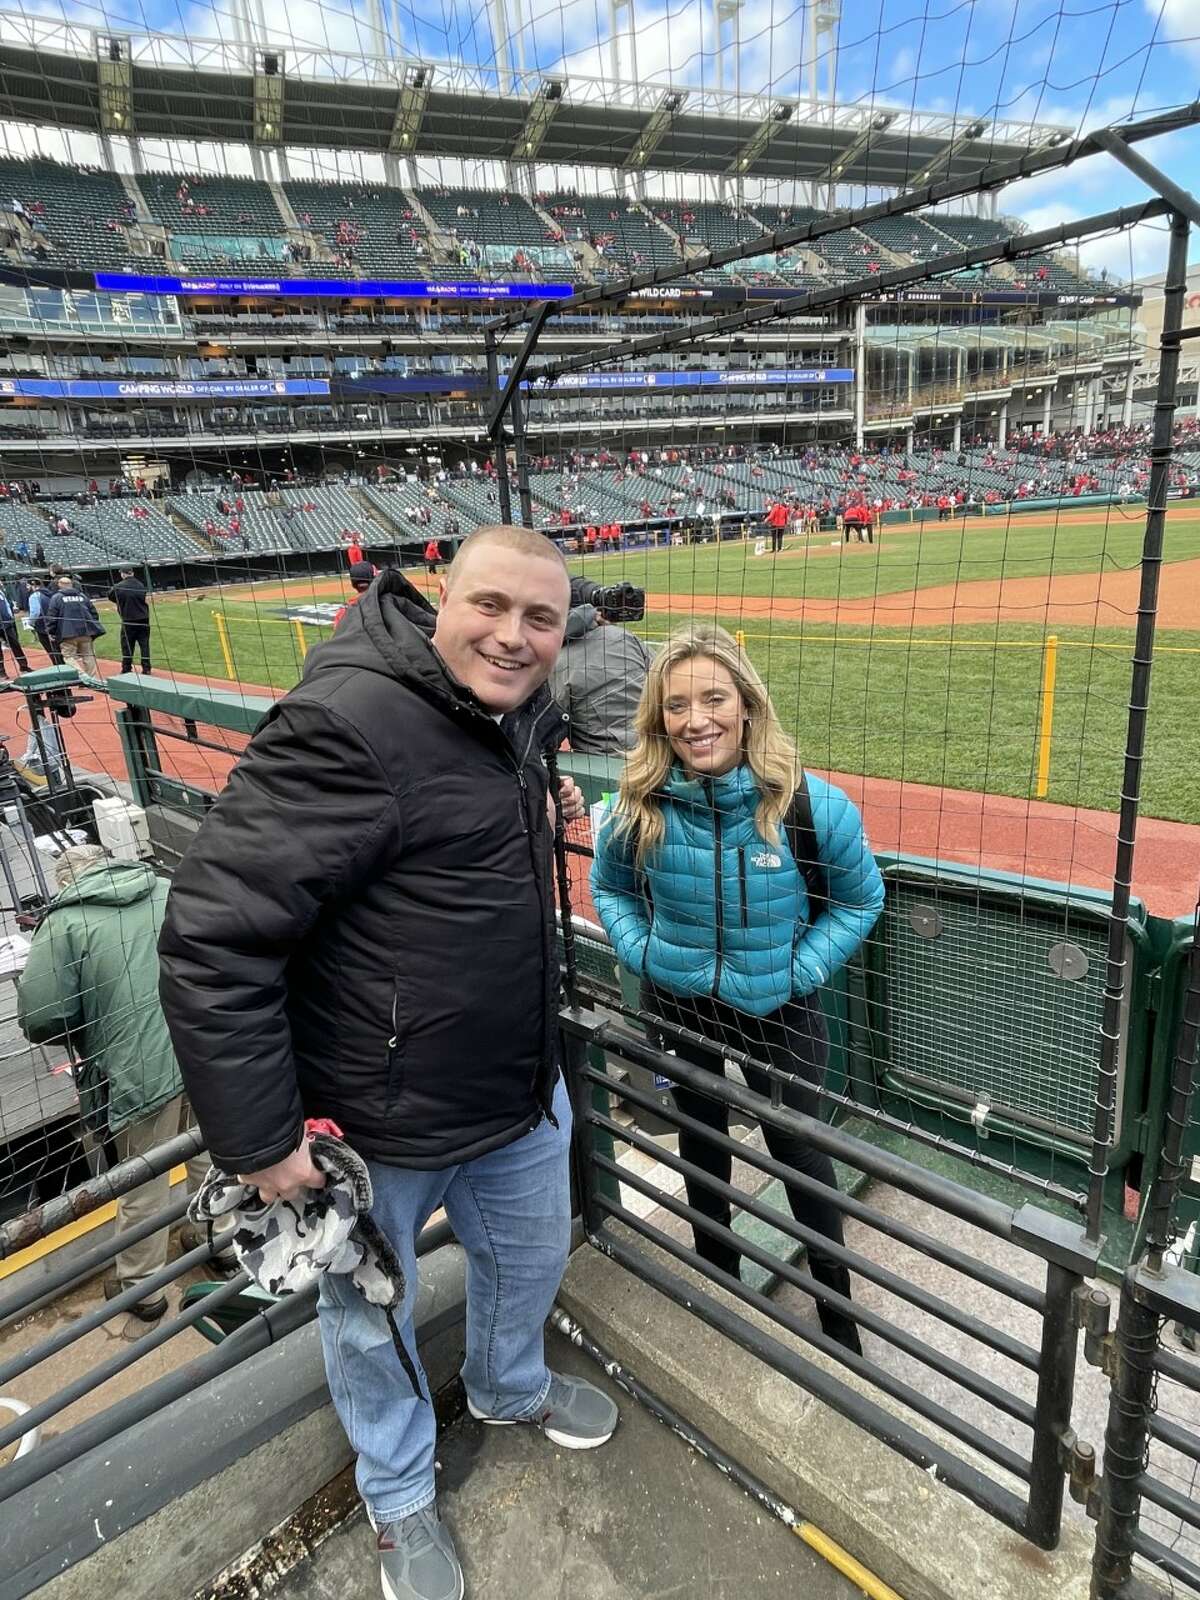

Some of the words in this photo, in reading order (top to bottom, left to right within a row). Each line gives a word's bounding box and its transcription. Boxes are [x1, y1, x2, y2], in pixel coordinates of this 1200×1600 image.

[639, 288, 660, 297] WILD
[660, 288, 681, 297] CARD
[118, 384, 161, 394] CAMPING
[160, 384, 195, 394] WORLD
[235, 384, 259, 392] DEALER
